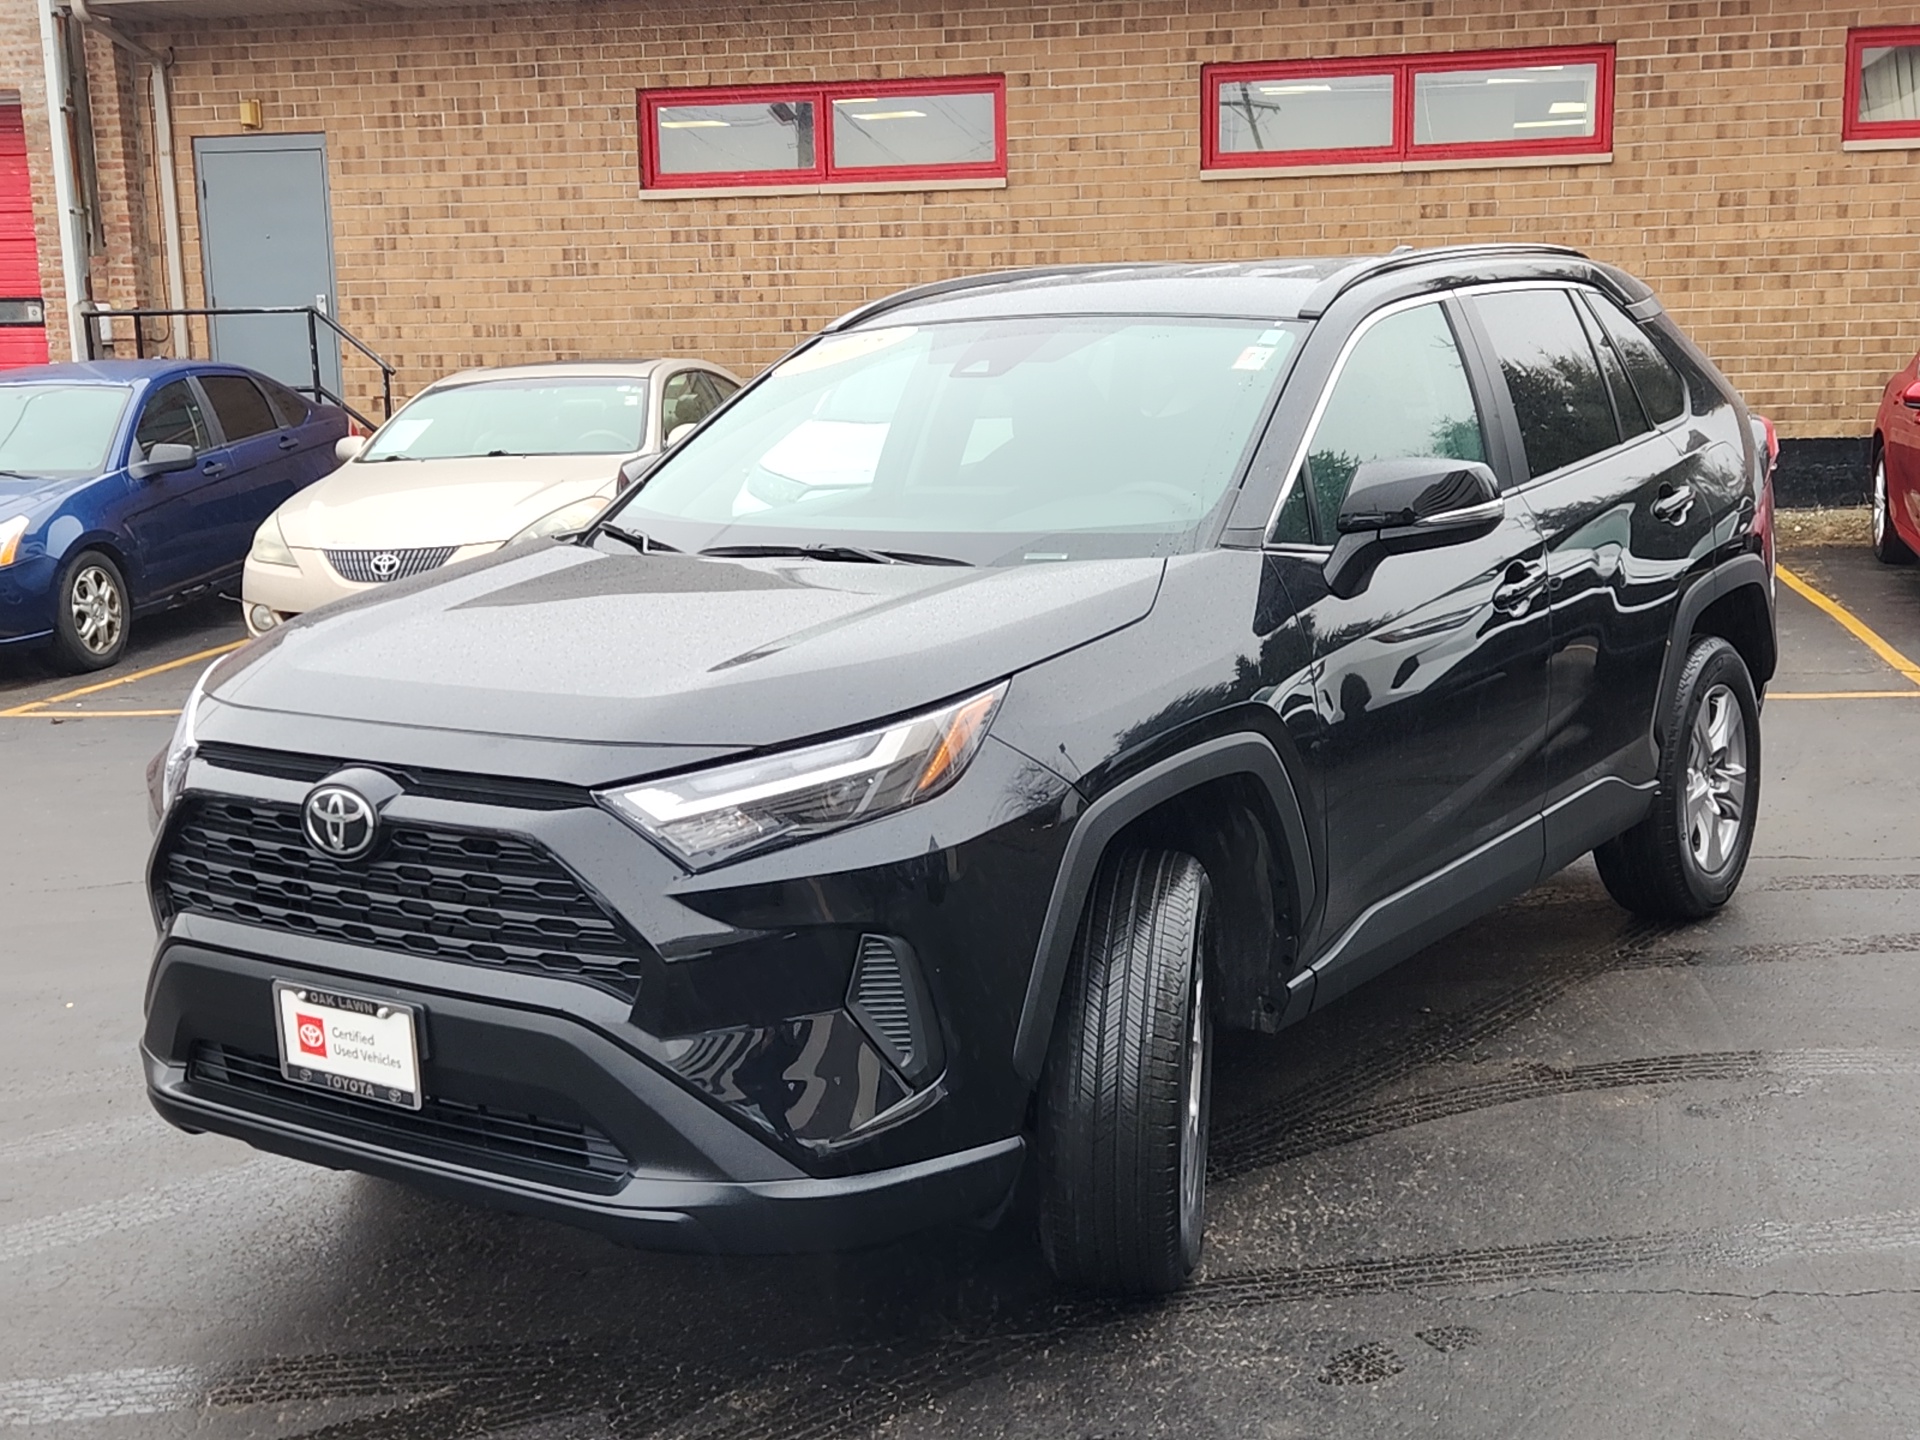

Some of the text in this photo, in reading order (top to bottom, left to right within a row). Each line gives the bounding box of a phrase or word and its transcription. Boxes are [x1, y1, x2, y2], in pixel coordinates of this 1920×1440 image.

[310, 992, 375, 1014] OAK LAWN
[332, 1027, 375, 1046] Certified
[334, 1044, 402, 1069] Used Vehicles
[325, 1073, 375, 1097] TOYOTA
